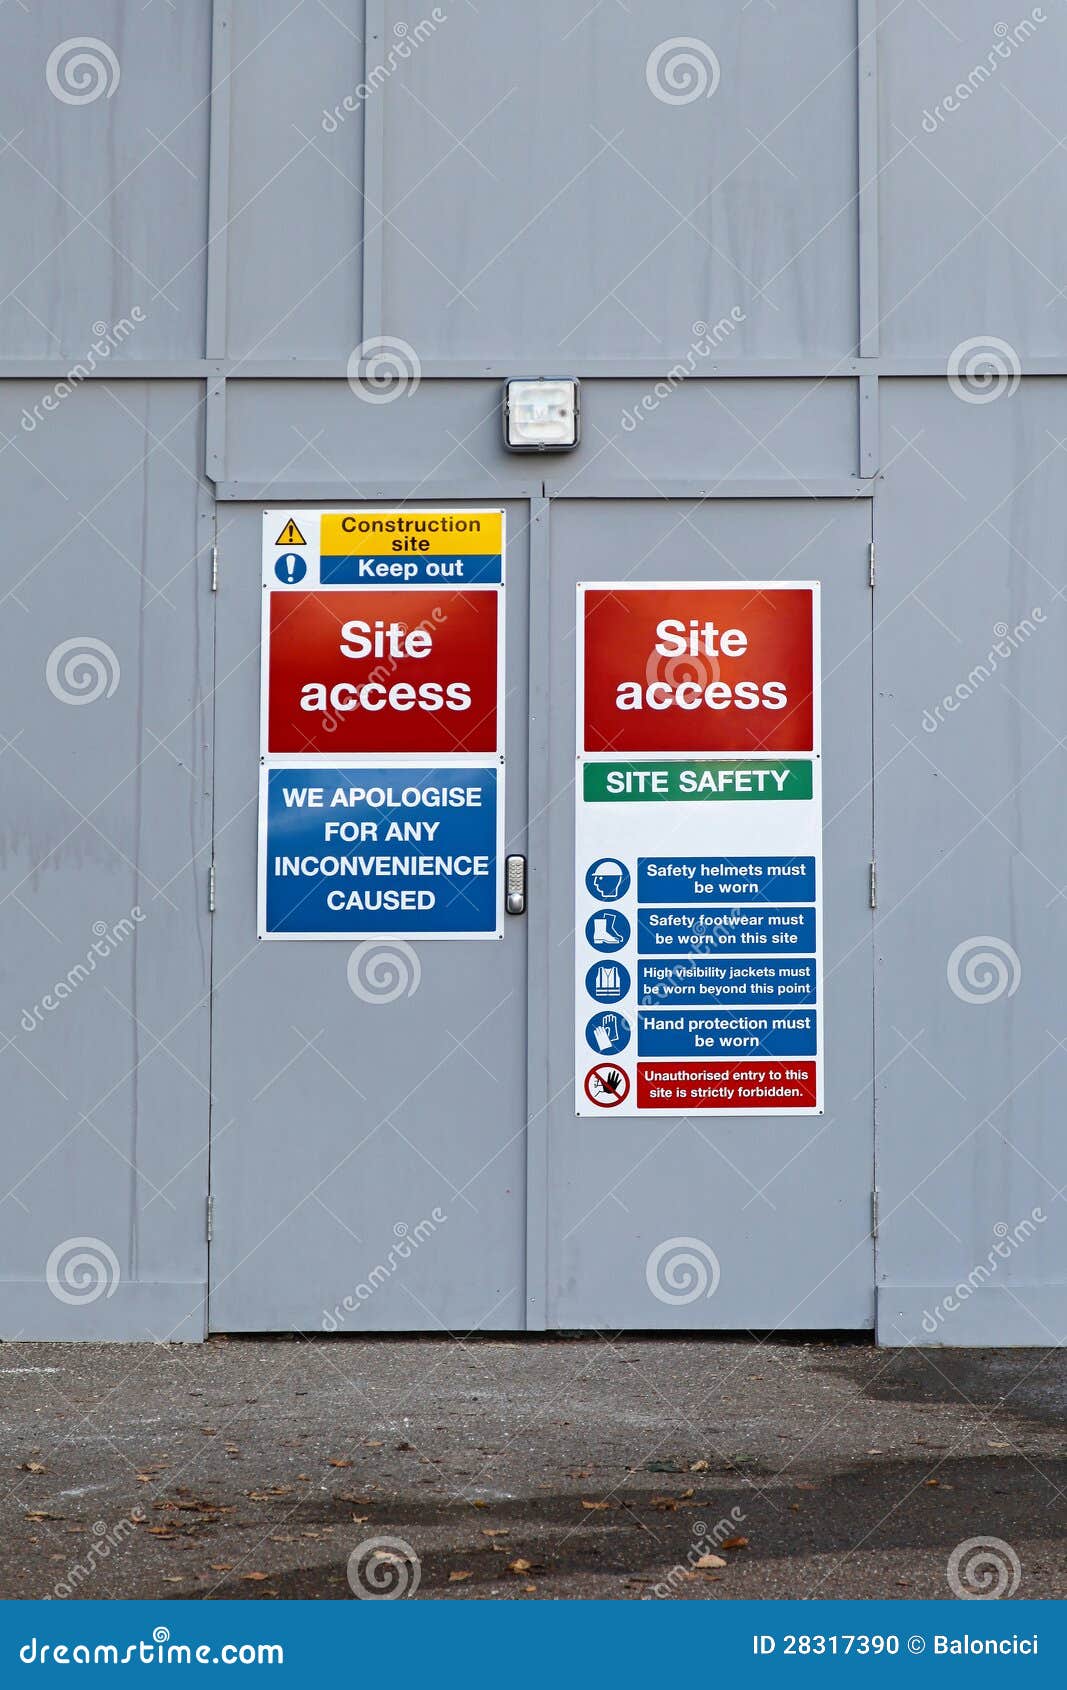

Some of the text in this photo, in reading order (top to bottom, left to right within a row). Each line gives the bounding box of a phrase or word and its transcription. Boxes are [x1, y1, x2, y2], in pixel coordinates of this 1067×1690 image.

[341, 516, 481, 533] Construction
[391, 535, 430, 552] site
[358, 558, 464, 581] Keep out
[339, 620, 433, 659] Site
[654, 619, 748, 658] Site
[300, 682, 472, 712] access
[615, 680, 788, 711] access
[606, 769, 791, 794] SITE SAFETY
[282, 786, 482, 808] WE APOLOGISE
[324, 821, 440, 842] FOR ANY
[275, 855, 489, 877] INCONVENIENCE
[646, 863, 806, 879] Safety helmets must
[694, 880, 759, 894] be worn
[326, 890, 436, 911] CAUSED
[649, 914, 804, 929] Safety footwear must
[655, 932, 798, 945] be worn on this site
[643, 966, 811, 980] High visibility jackets must
[643, 983, 811, 996] be worn beyond this point
[644, 1016, 811, 1033] Hand protection must
[695, 1034, 760, 1047] be worn
[644, 1069, 809, 1083] Unauthorised entry to this
[649, 1086, 803, 1100] site is strictly forbidden.
